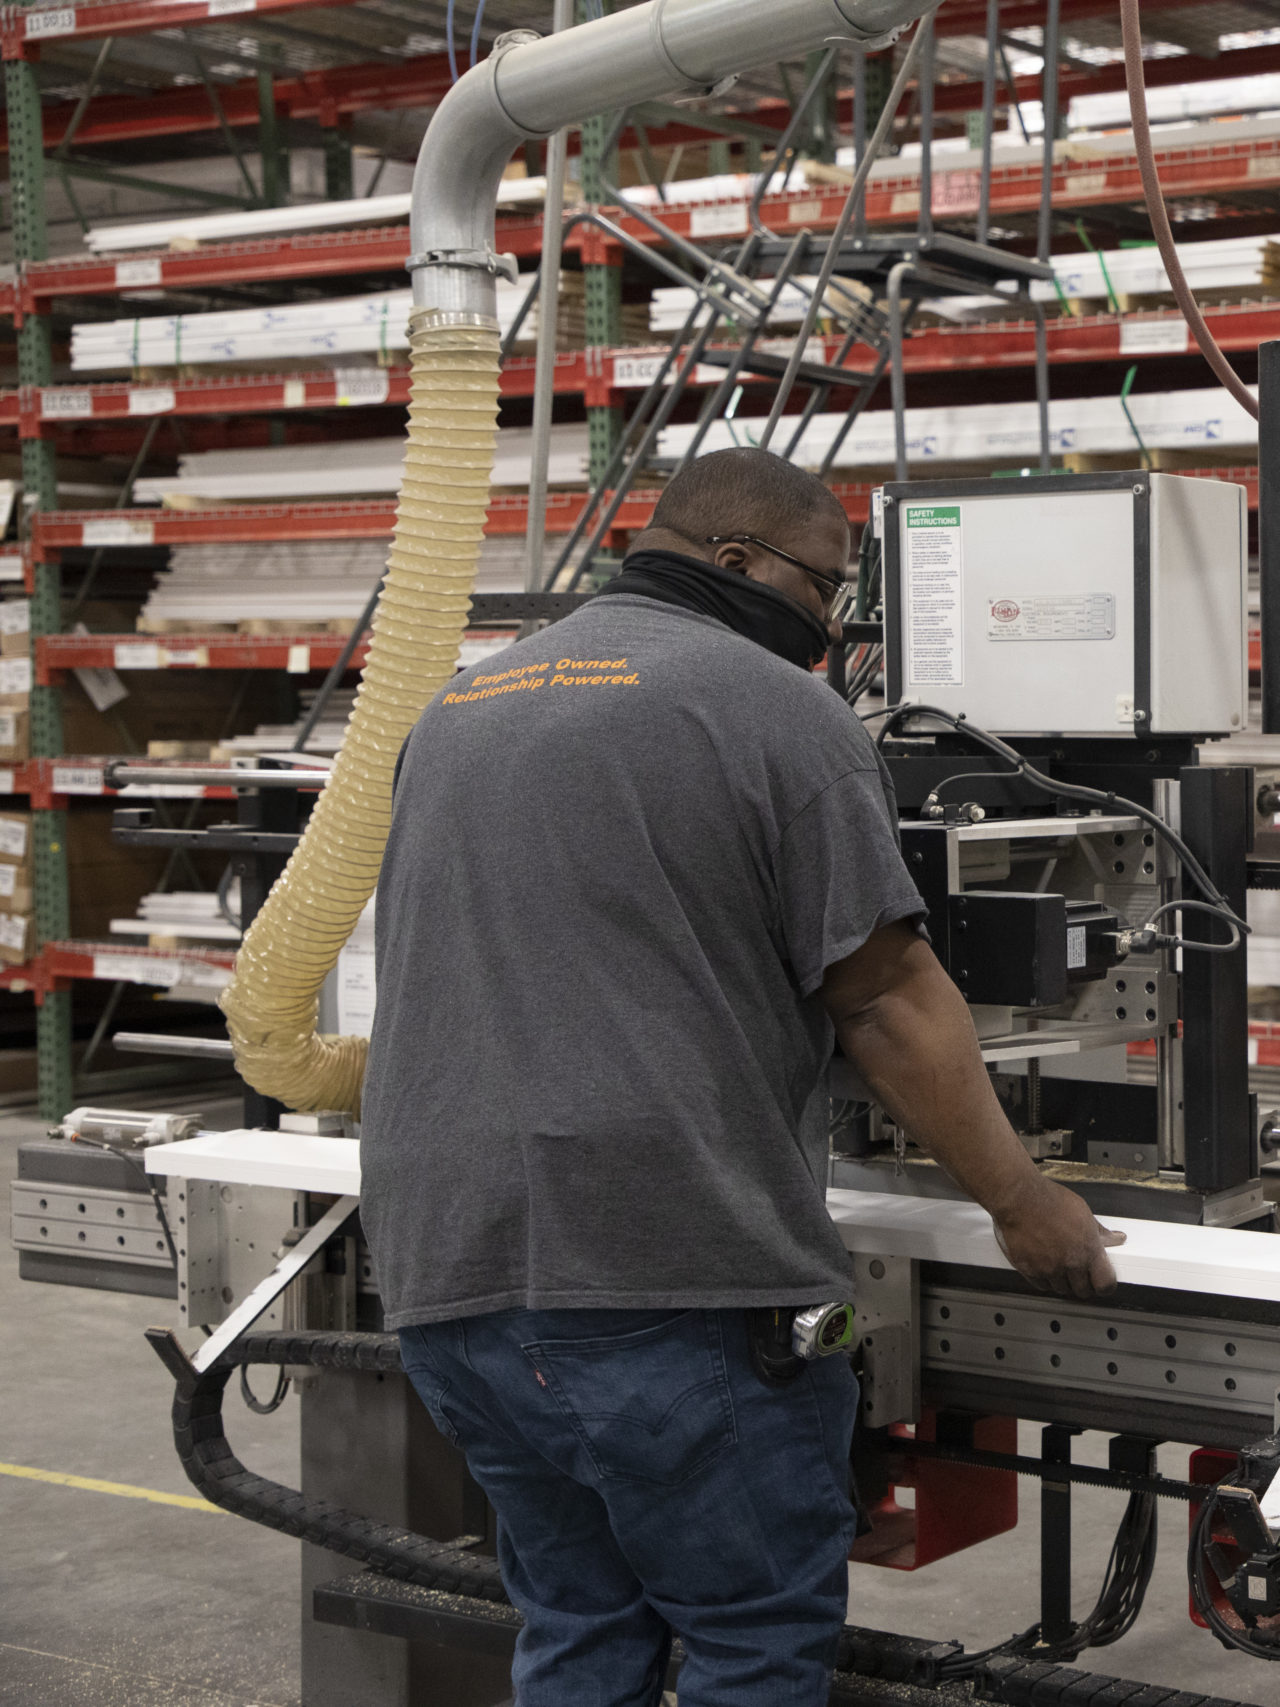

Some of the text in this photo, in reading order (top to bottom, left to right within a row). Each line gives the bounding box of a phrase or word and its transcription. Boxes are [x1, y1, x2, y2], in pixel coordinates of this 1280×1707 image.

[909, 510, 935, 518] SAFETY
[909, 517, 957, 526] INSTRUCTIONS
[471, 658, 628, 687] Employee Owned.
[442, 672, 641, 705] Relationship Powered.
